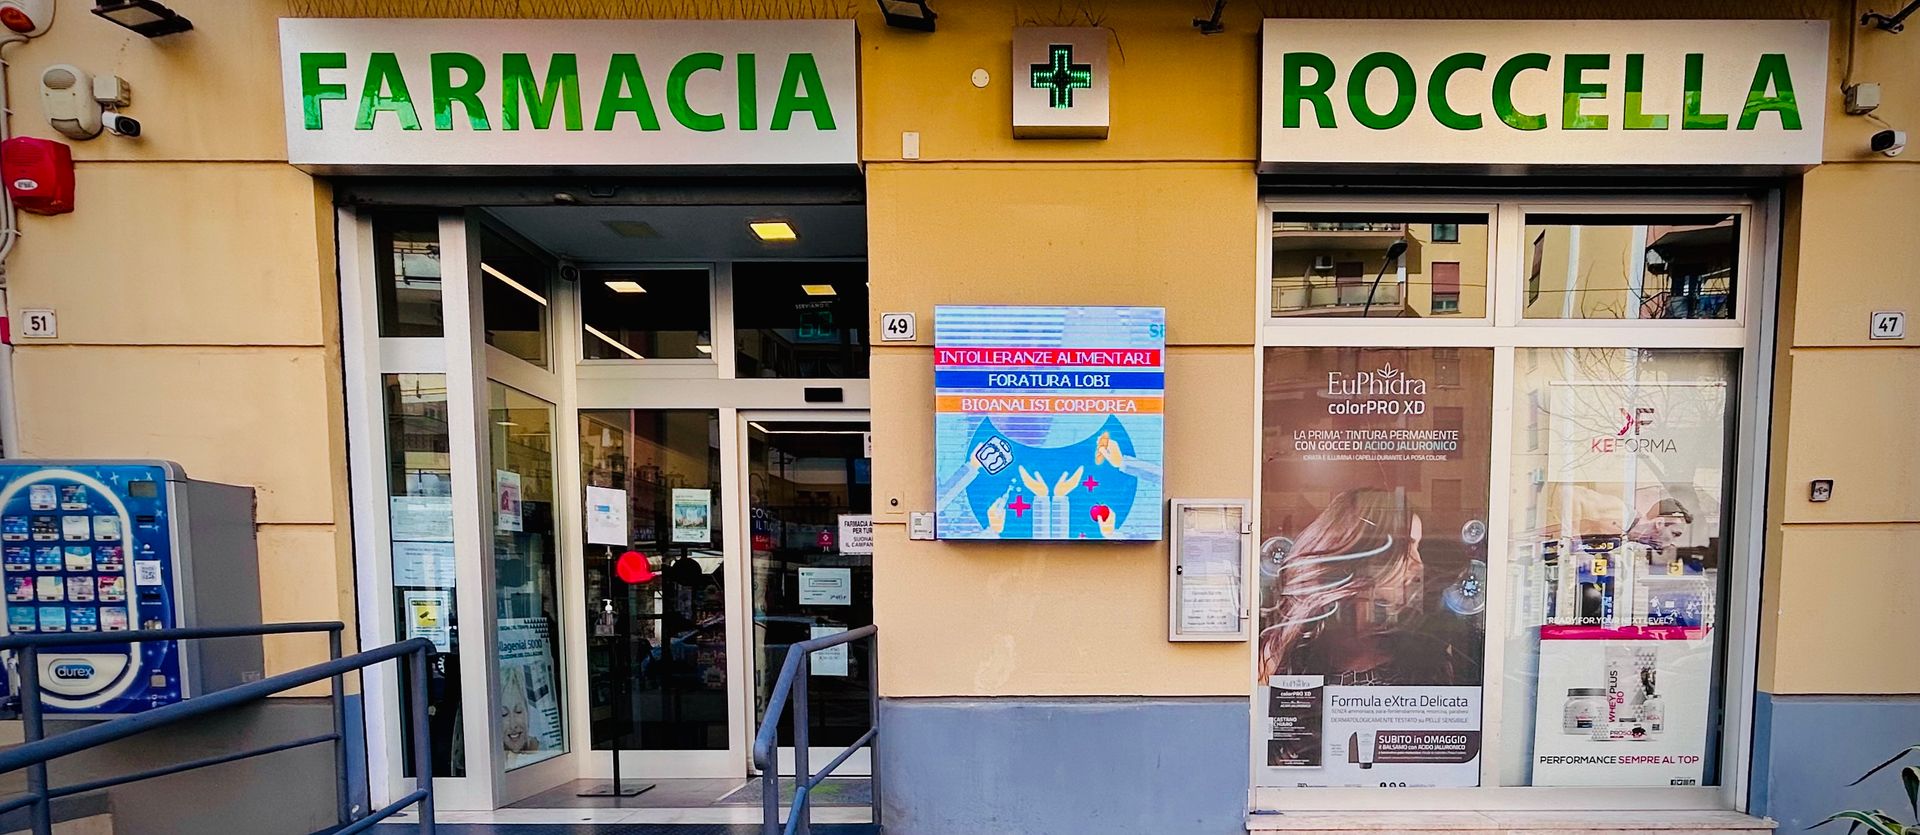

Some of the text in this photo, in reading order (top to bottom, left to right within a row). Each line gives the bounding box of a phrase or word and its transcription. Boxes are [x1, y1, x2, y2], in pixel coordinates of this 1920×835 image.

[300, 52, 836, 131] FARMACIA
[1282, 51, 1802, 131] ROCCELLA
[31, 315, 47, 332] 51
[888, 318, 908, 334] 49
[1879, 316, 1898, 332] 47
[939, 350, 1152, 365] INTOLLERANZE ALIMENTARI
[988, 374, 1110, 387] FORATURA LOBI
[1327, 370, 1426, 395] EuPhidra
[962, 399, 1136, 412] BIOANALISI CORPOREA
[1328, 400, 1425, 415] colorPRO XD
[1294, 430, 1306, 440] LA
[1345, 430, 1388, 440] TINTURA
[1390, 430, 1458, 440] PERMANENTE
[1295, 441, 1457, 451] CON GOCCE DI ACIDO JALURONICO
[1591, 439, 1677, 453] KEFORMA
[1548, 616, 1577, 625] READY
[1596, 616, 1620, 625] YOUR
[528, 638, 542, 649] 5000
[57, 666, 92, 678] durex
[1331, 694, 1468, 707] Formula eXtra Delicata
[1608, 670, 1618, 723] WHEY PLUS
[1616, 690, 1625, 704] 80
[1378, 735, 1467, 744] SUBITO in OMAGGIO
[1540, 756, 1699, 764] PERFORMANCE SEMPRE AL TOP
